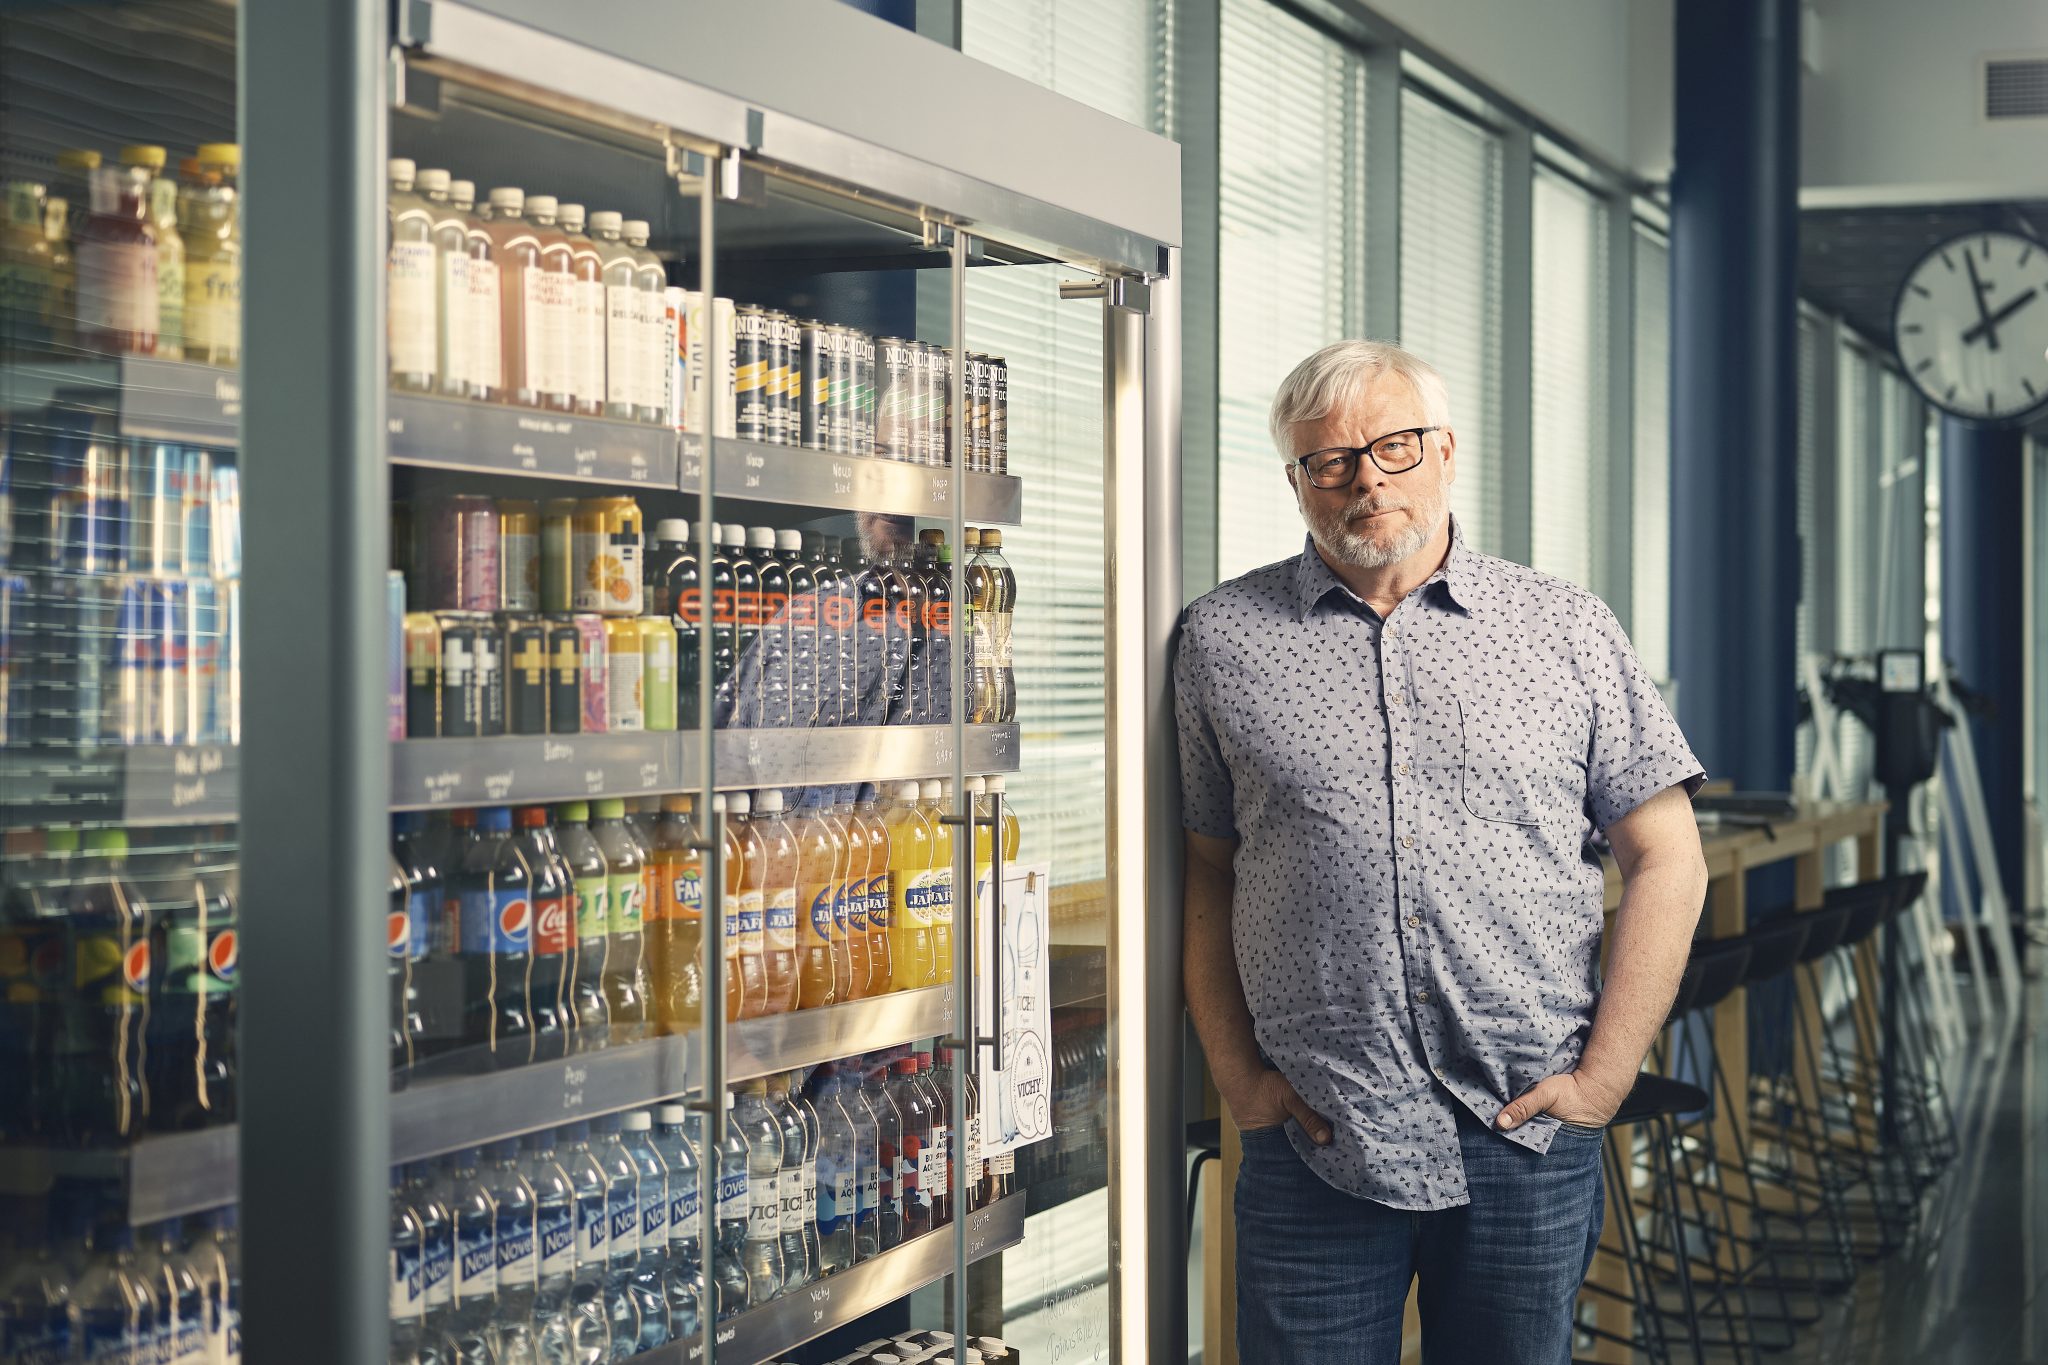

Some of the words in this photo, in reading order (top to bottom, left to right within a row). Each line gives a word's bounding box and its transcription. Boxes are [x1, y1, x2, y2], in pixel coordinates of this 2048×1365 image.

[970, 361, 990, 380] NOC
[990, 367, 1008, 384] NOC
[973, 386, 990, 399] FOC
[994, 390, 1008, 403] FOC
[673, 878, 703, 901] FAN
[1017, 1078, 1041, 1098] VICHY
[972, 1212, 990, 1232] Sprite
[810, 1286, 831, 1303] Vichy
